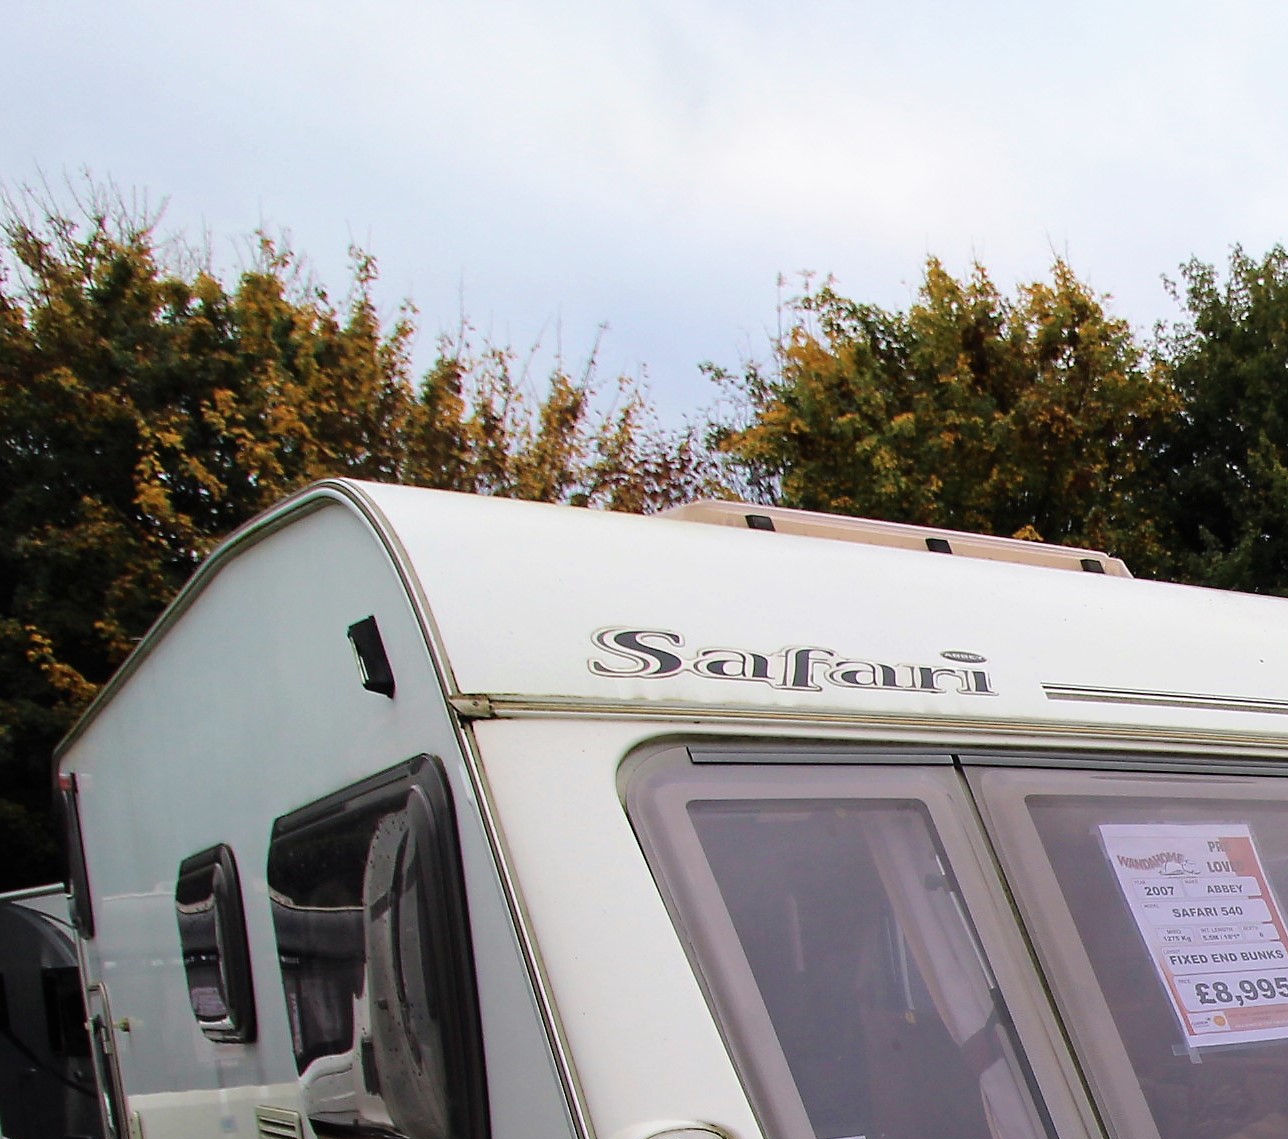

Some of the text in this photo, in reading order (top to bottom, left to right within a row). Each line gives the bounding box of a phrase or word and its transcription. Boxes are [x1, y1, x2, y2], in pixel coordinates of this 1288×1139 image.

[588, 626, 999, 696] Safari
[1144, 886, 1174, 896] 2007
[1207, 884, 1243, 894] ABBEY
[1172, 906, 1243, 918] SAFARI 540
[1169, 950, 1284, 966] FIXED END BUNKS
